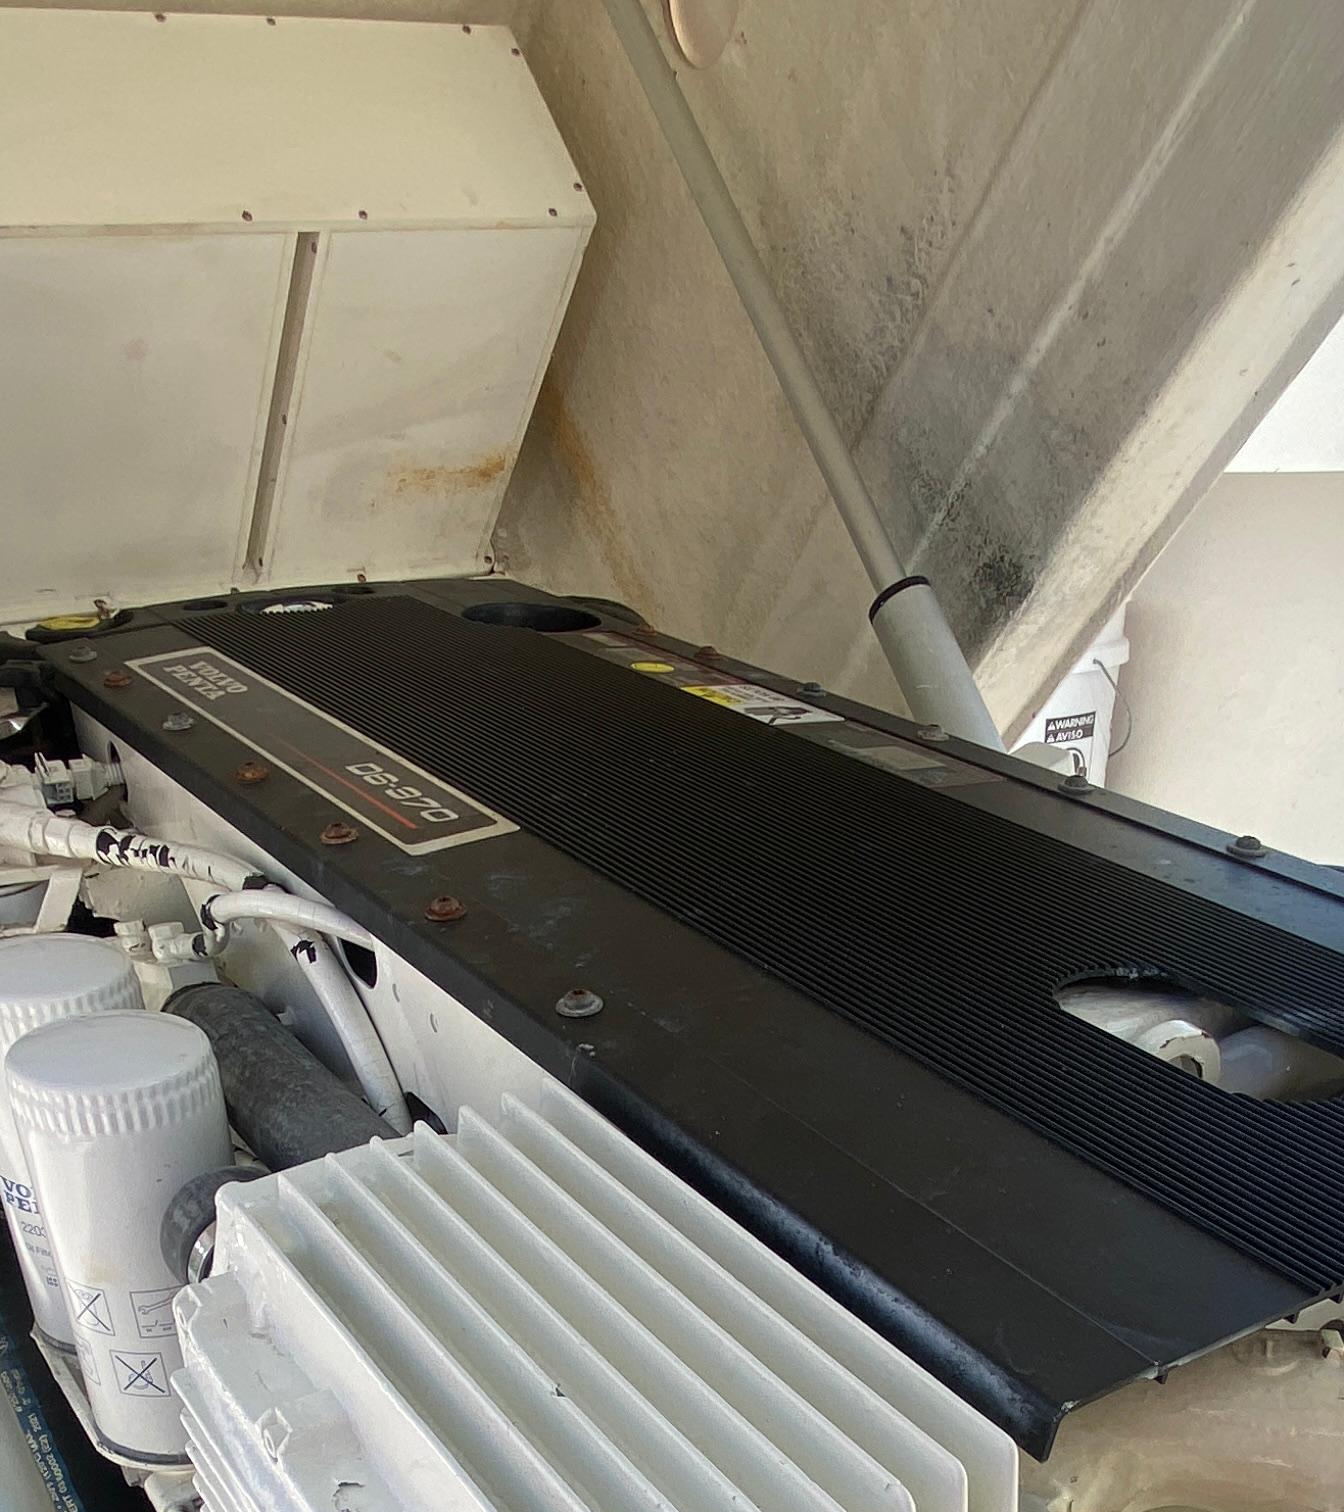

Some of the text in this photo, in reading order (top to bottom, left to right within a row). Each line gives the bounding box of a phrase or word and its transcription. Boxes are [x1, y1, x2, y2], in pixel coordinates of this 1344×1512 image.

[162, 664, 227, 700] PENTA
[189, 661, 248, 693] VOLVO
[1055, 714, 1094, 730] WARNING
[1055, 729, 1083, 742] AVISO
